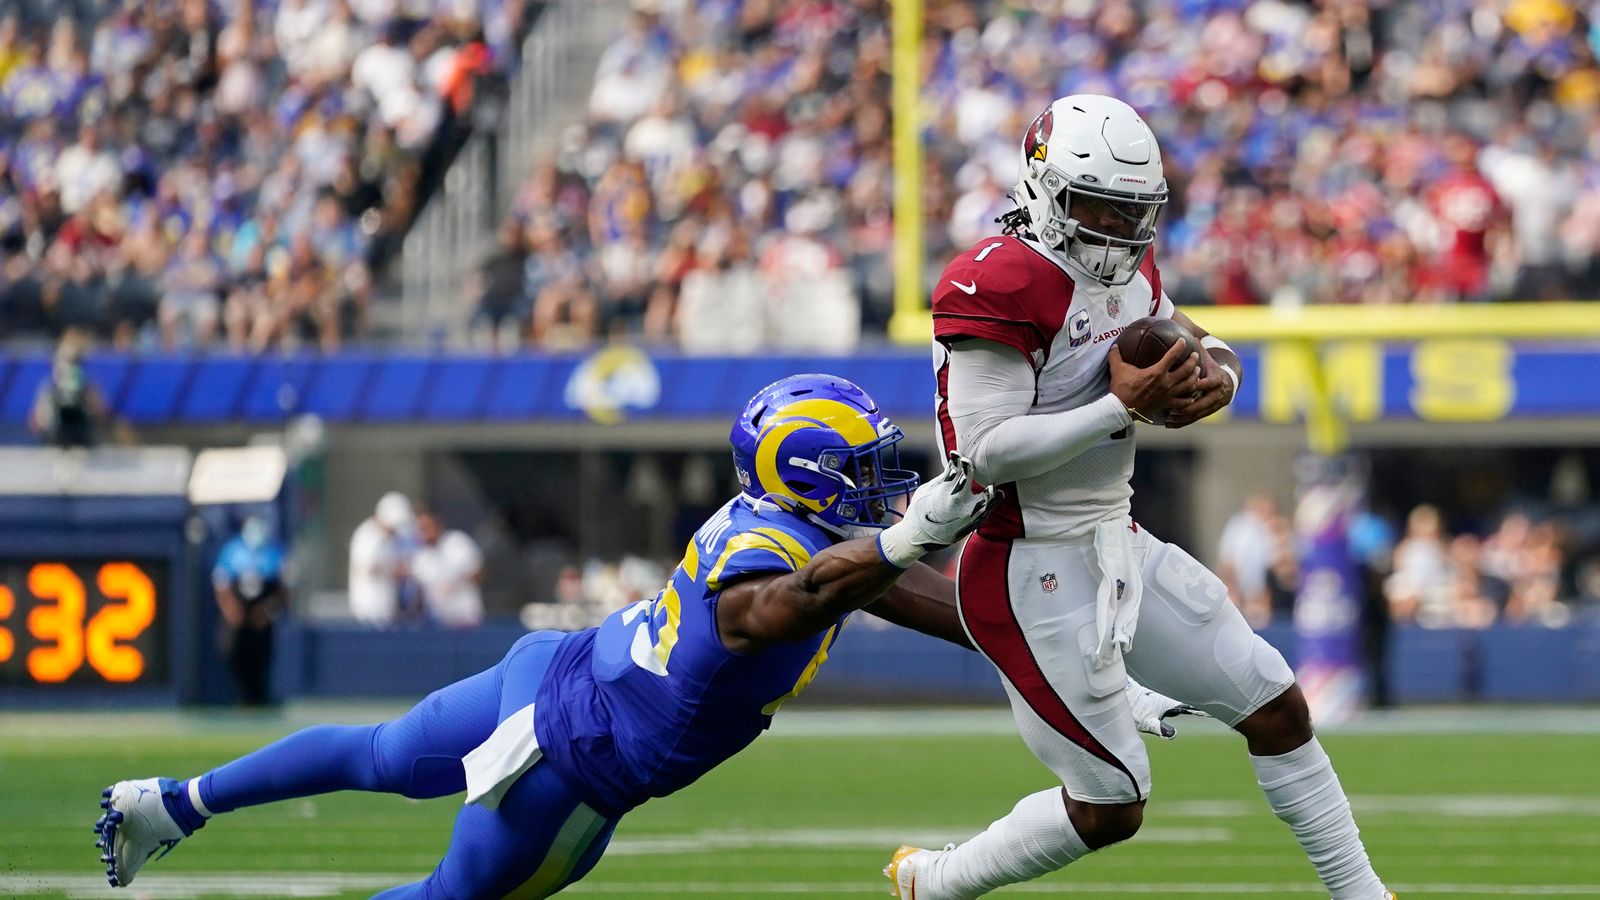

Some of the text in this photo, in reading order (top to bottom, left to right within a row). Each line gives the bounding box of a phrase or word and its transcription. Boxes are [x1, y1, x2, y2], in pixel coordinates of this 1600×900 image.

[973, 242, 1004, 262] 1
[1070, 310, 1090, 340] C
[1261, 341, 1515, 423] MS
